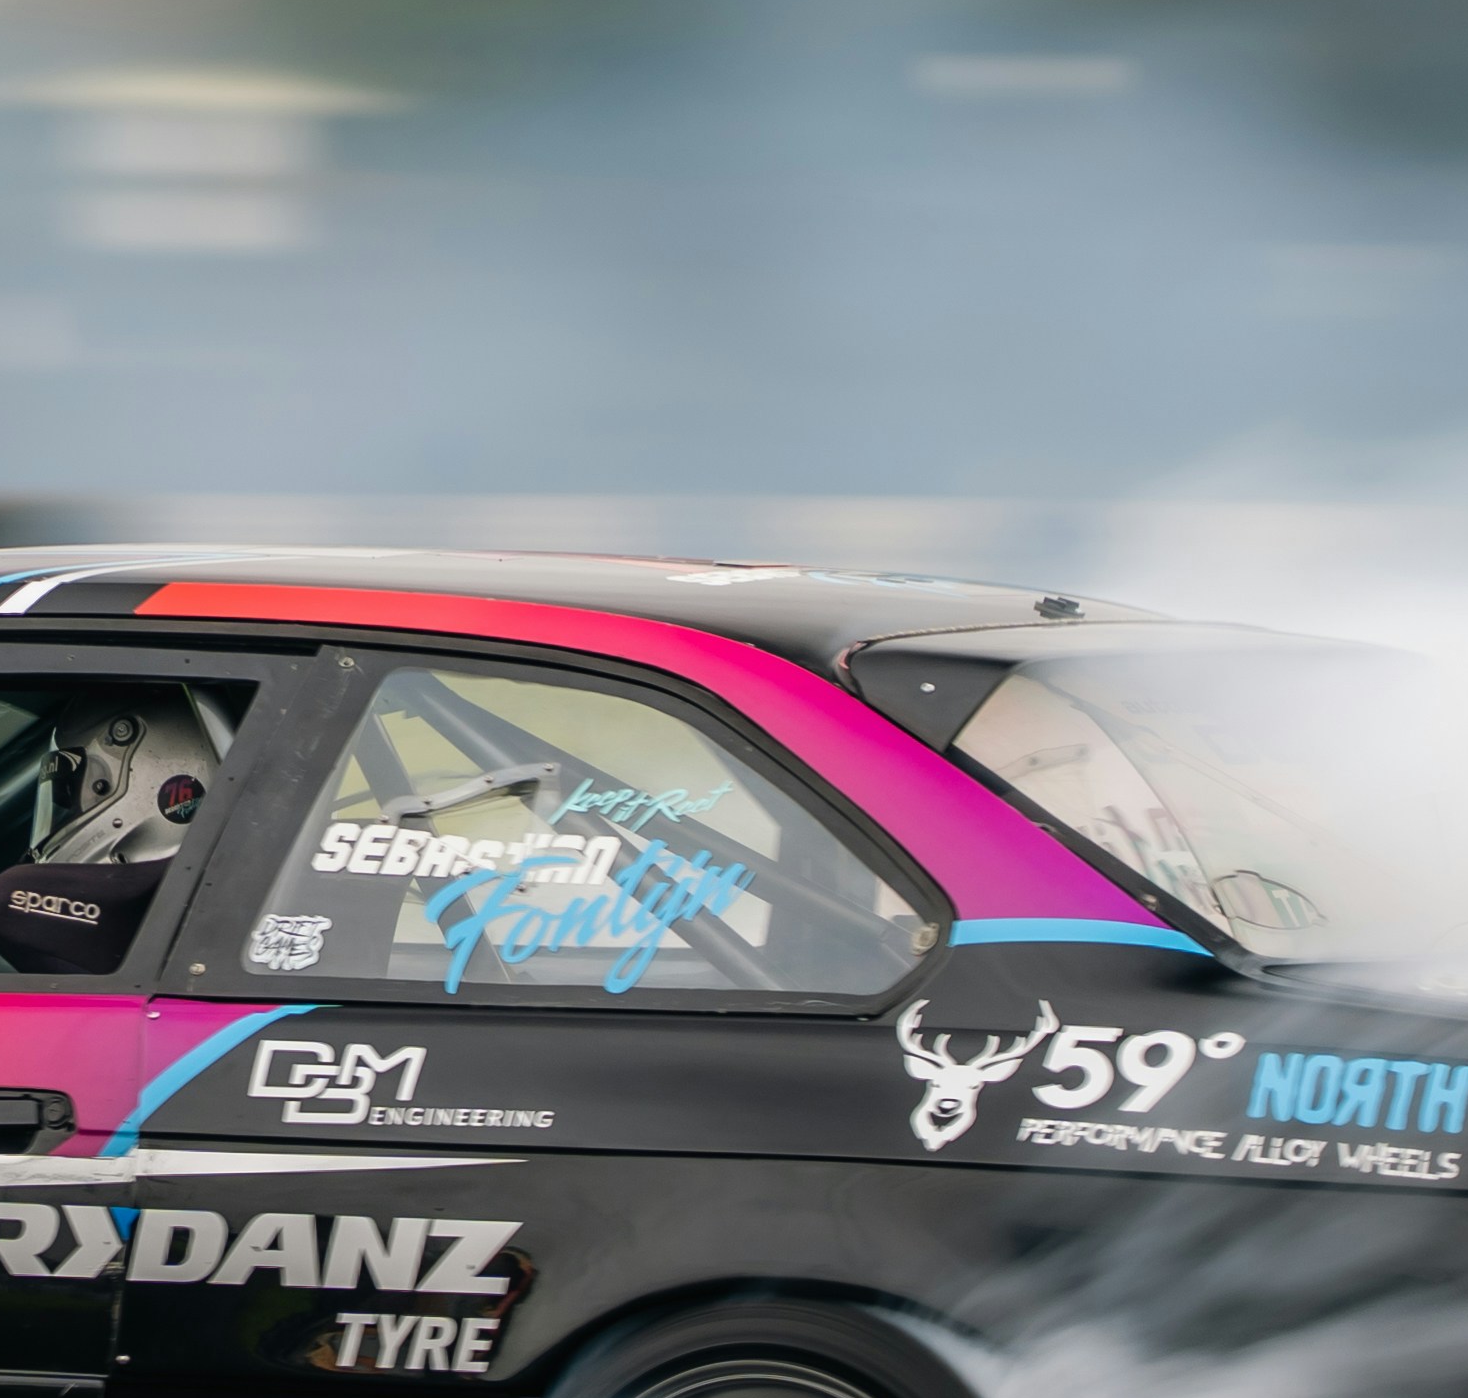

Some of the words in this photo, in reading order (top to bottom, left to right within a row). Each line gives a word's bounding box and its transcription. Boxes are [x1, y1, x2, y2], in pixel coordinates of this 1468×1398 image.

[10, 889, 101, 919] sparco
[367, 1107, 555, 1128] ENGINEERING
[1017, 1117, 1230, 1160] PERFORMANCE
[1231, 1133, 1326, 1166] ALLOY
[1336, 1142, 1463, 1179] WHEELS
[336, 1313, 501, 1372] TYRE
